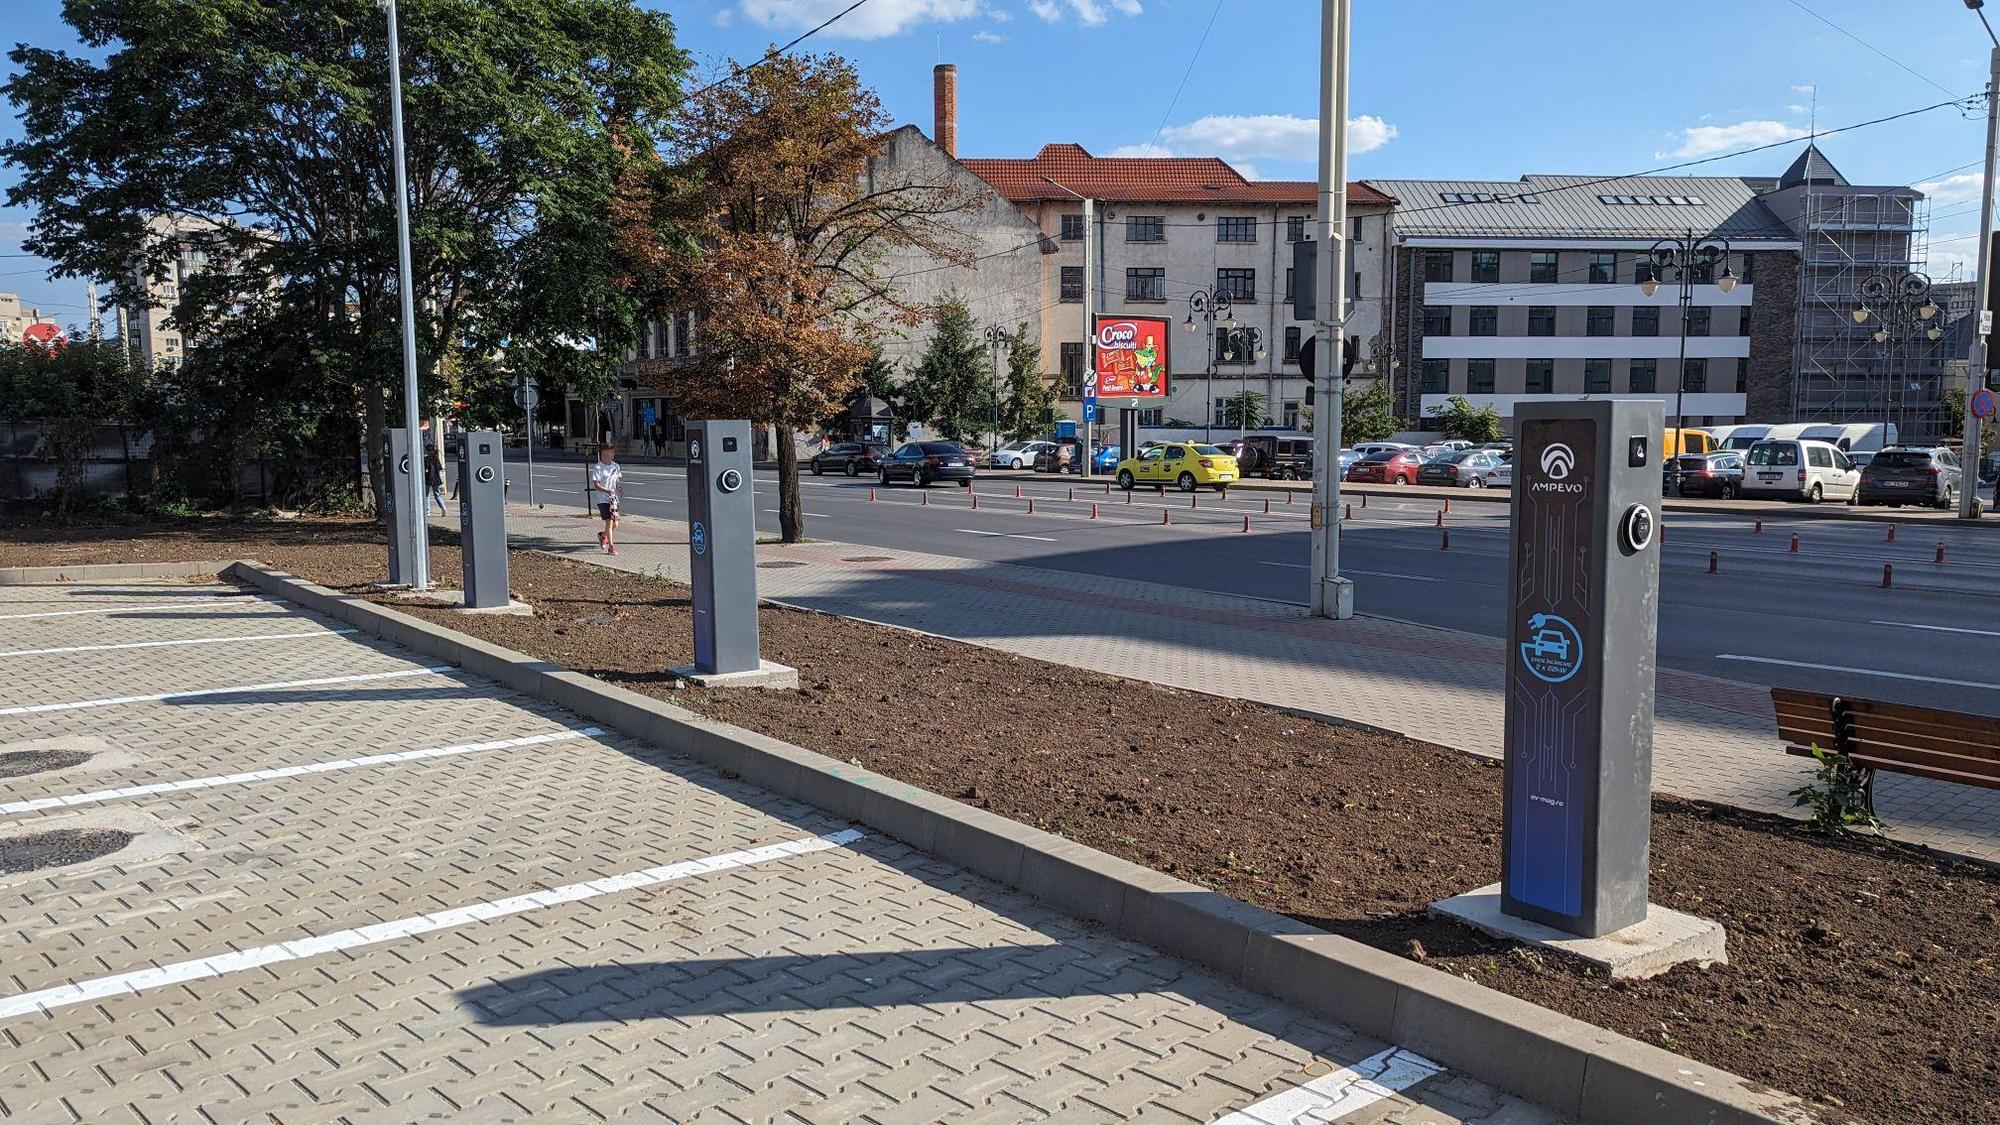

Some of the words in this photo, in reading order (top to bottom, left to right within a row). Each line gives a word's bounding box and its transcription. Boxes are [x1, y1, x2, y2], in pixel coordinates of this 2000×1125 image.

[1102, 326, 1133, 343] Croco
[1086, 404, 1094, 418] P
[1531, 482, 1583, 493] AMPEVO
[1530, 794, 1564, 806] ev-mag.ro
